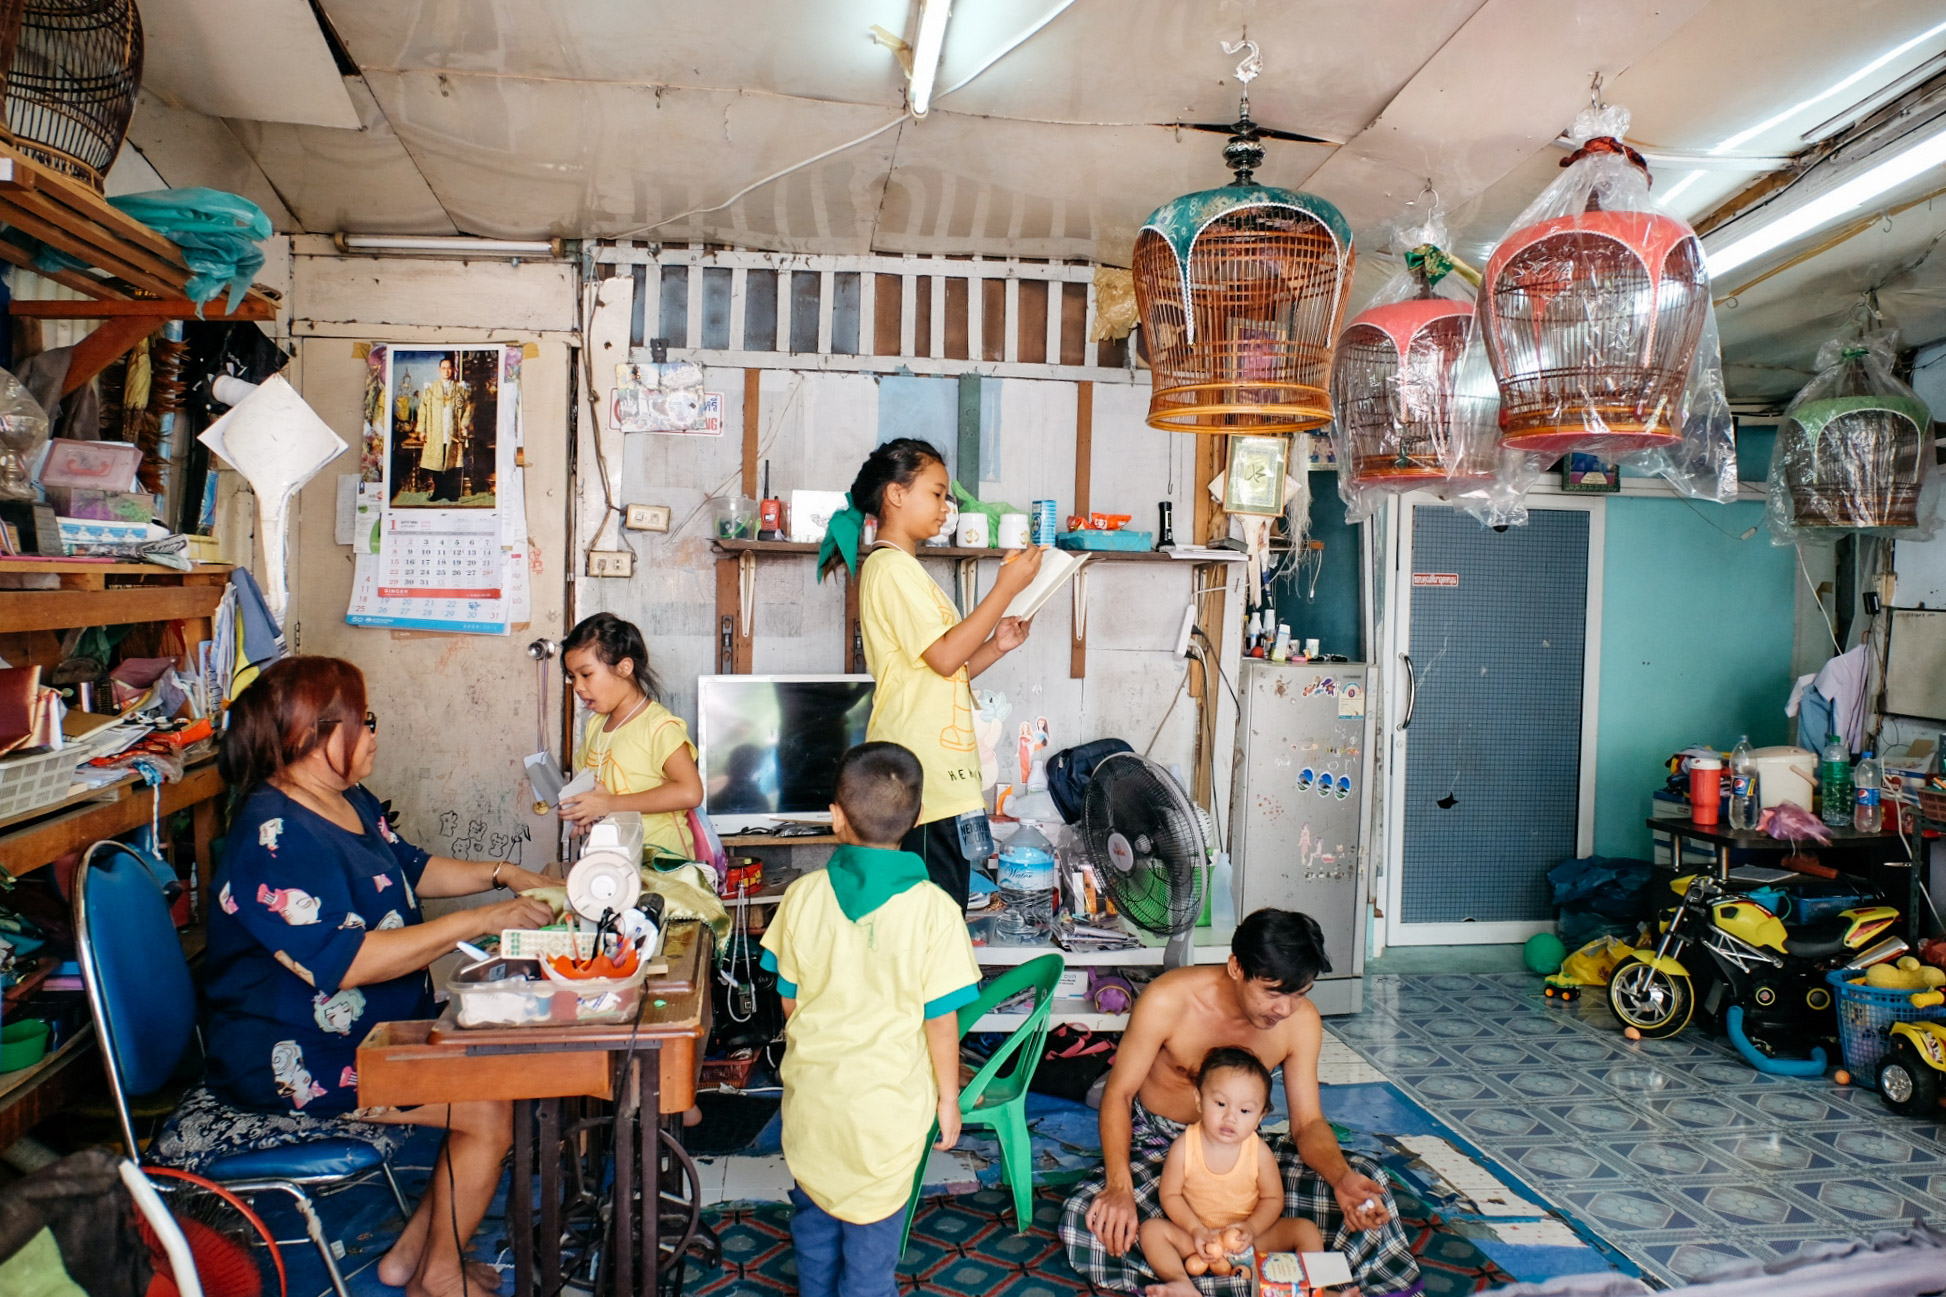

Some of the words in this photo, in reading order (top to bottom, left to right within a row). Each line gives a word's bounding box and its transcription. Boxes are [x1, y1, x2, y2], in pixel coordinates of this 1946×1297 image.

[390, 520, 397, 530] 1
[490, 612, 499, 620] 31
[1005, 866, 1033, 879] Water
